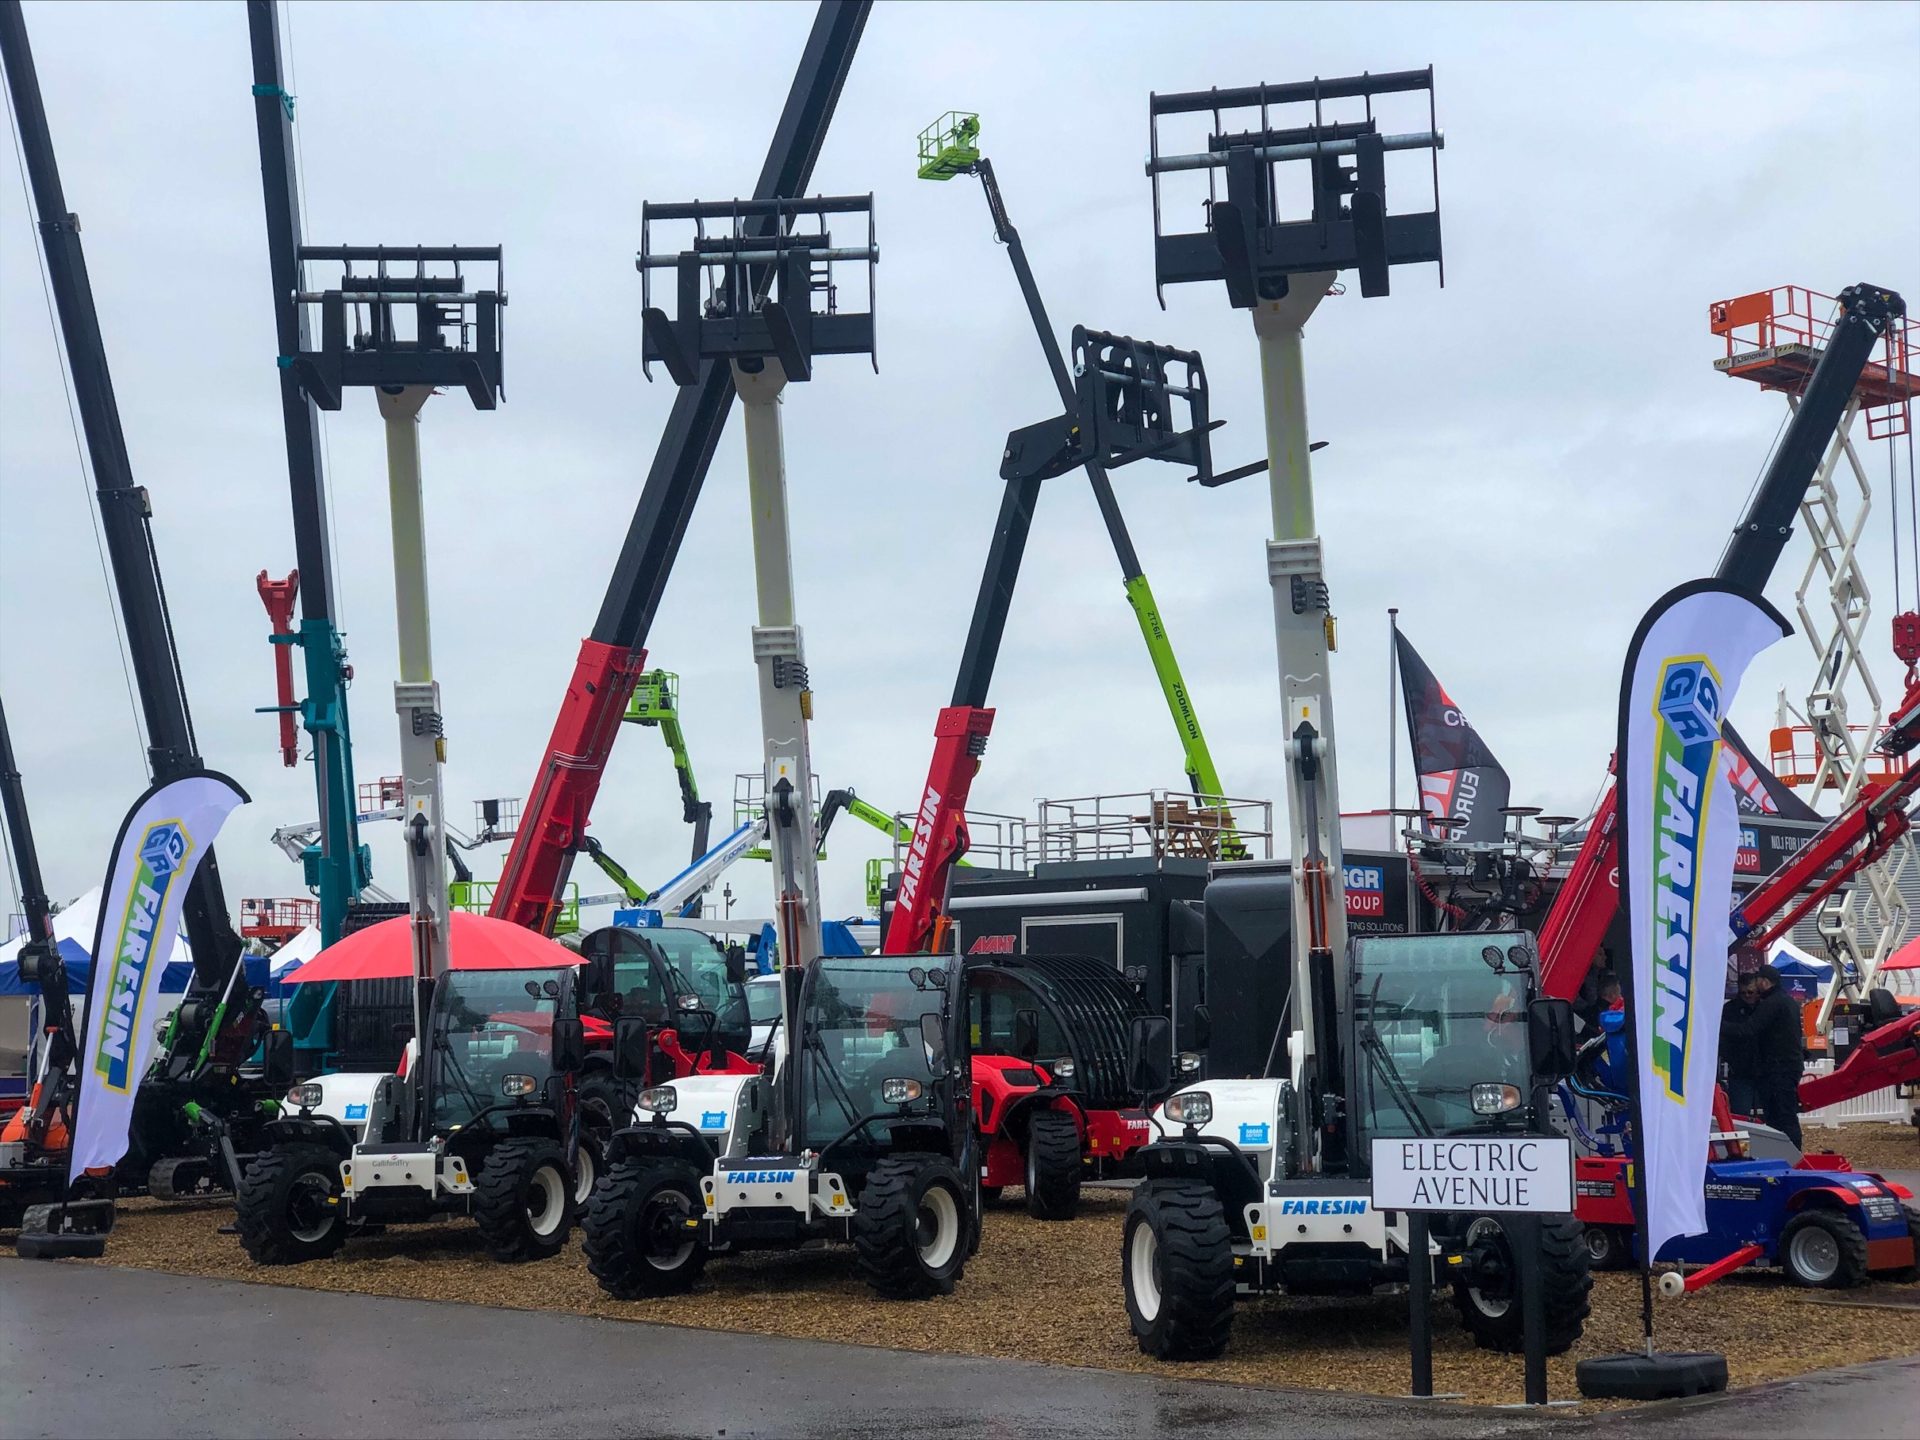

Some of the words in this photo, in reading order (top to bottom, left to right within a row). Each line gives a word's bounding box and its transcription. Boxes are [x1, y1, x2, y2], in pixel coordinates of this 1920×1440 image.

[1172, 682, 1199, 740] ZOOMLION
[899, 785, 942, 912] FARESIN
[1653, 751, 1699, 1052] FARESIN
[1366, 922, 1404, 932] SOLUTIONS
[968, 934, 1018, 954] AVANT
[101, 881, 161, 1063] FARESIN
[1401, 1142, 1539, 1172] ELECTRIC
[726, 1171, 796, 1184] FARESIN
[1411, 1176, 1530, 1206] AVENUE
[1281, 1200, 1367, 1215] FARESIN
